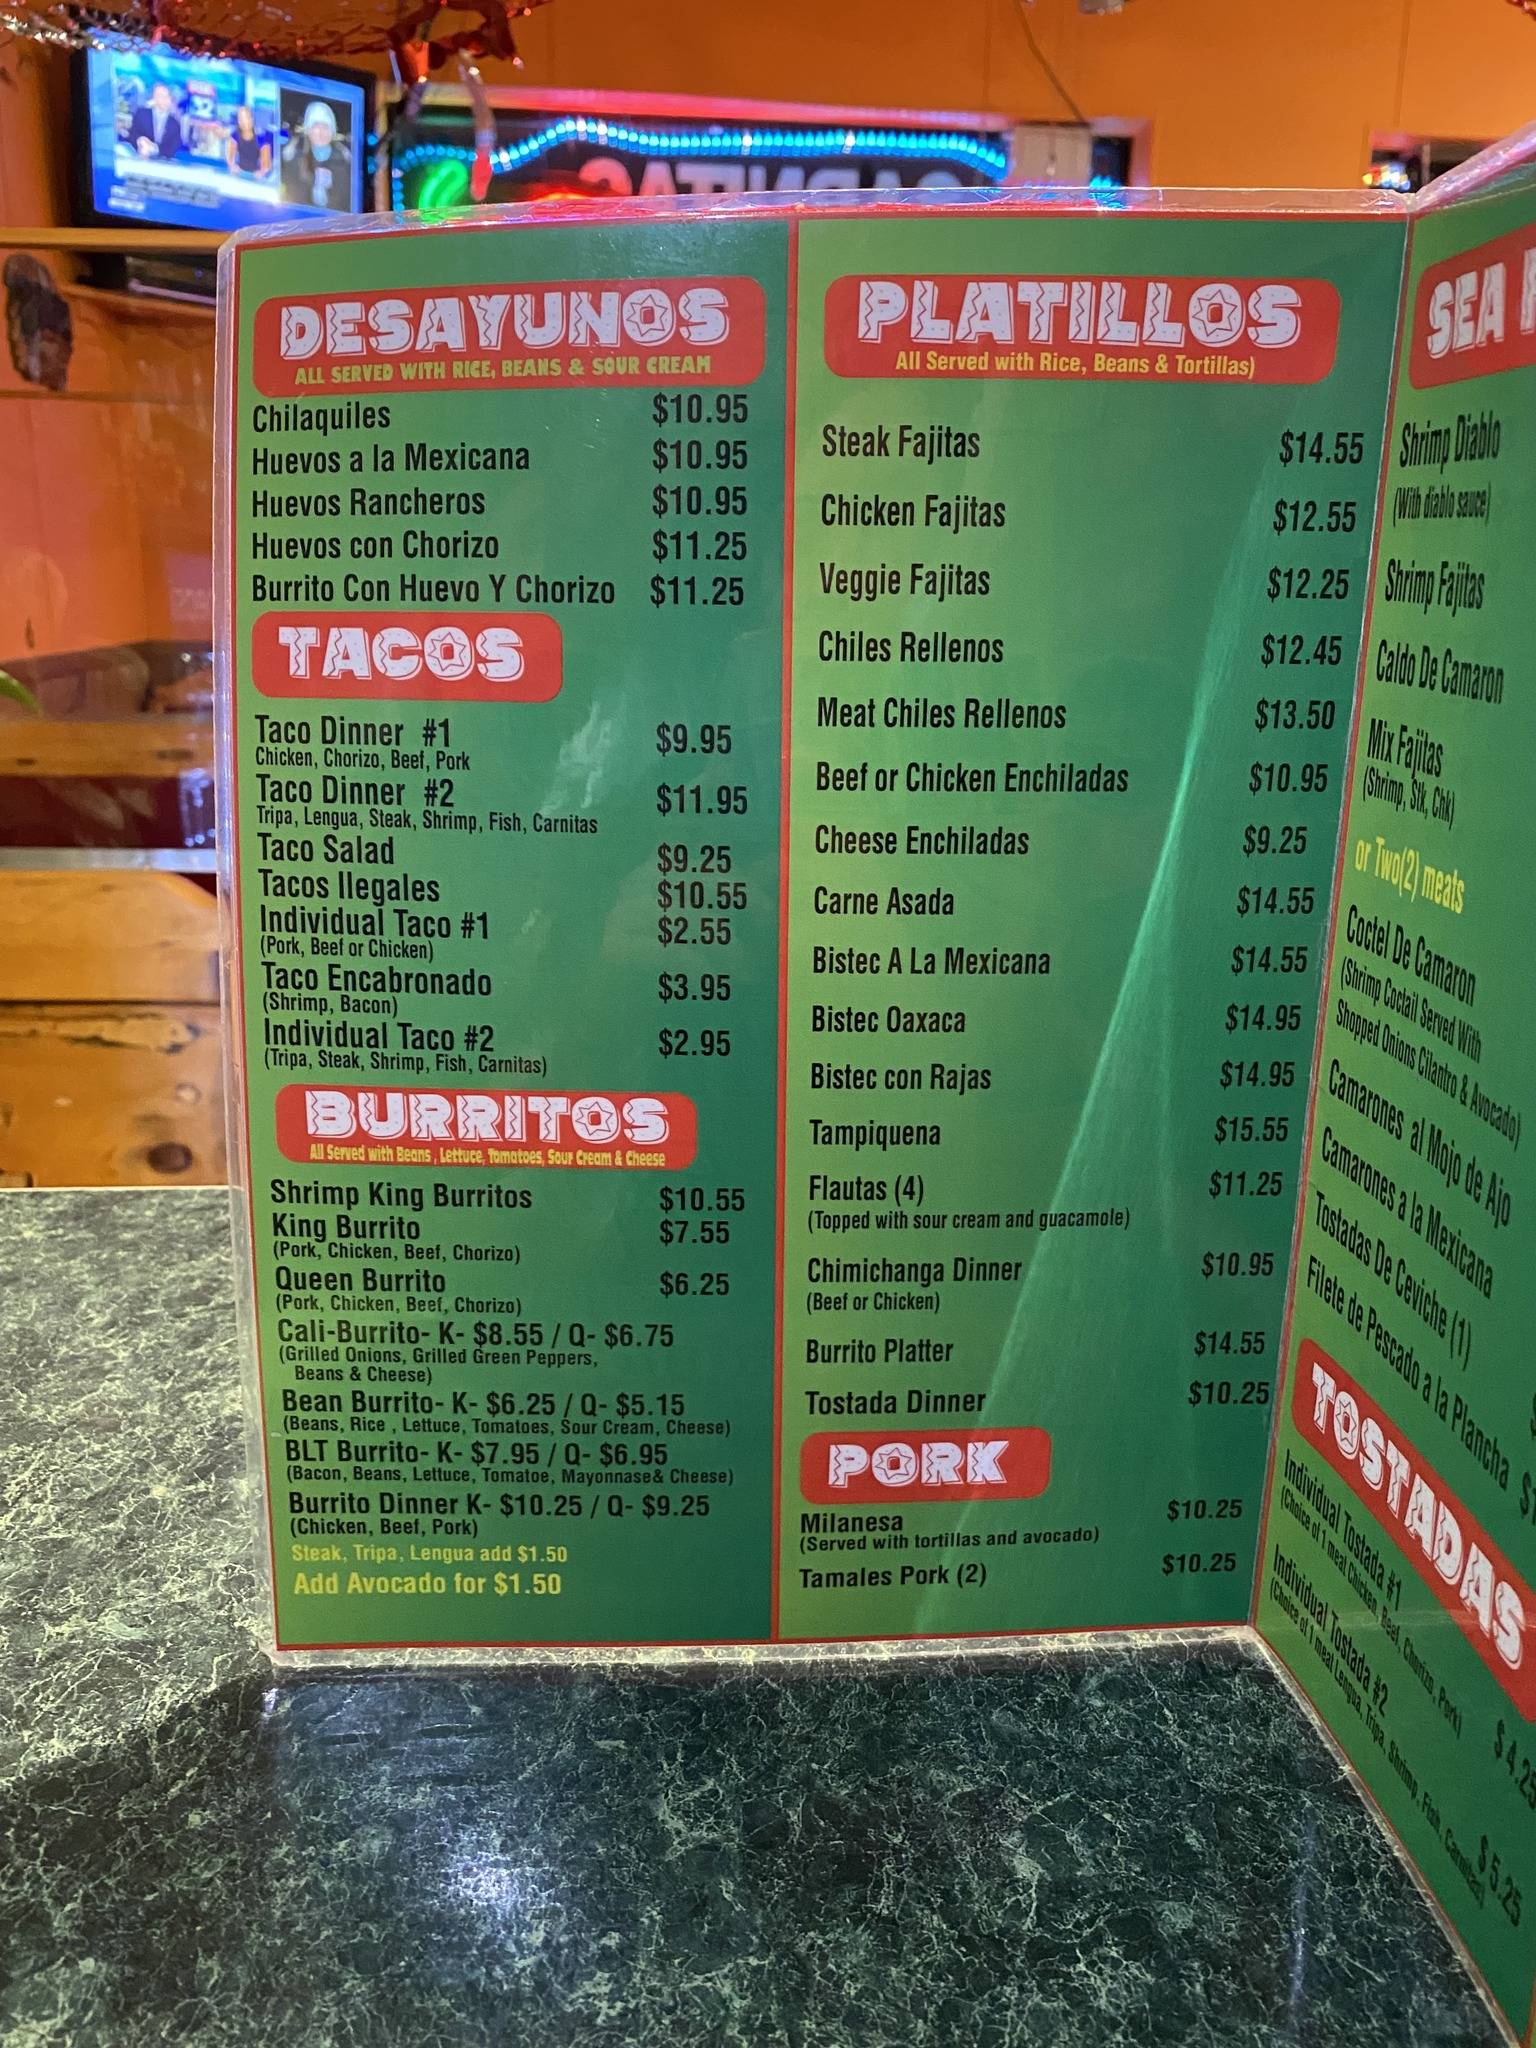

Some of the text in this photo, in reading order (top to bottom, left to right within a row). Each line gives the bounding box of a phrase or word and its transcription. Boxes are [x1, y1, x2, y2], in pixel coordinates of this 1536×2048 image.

[280, 288, 729, 360] DESAYUNOS
[857, 280, 1302, 349] PLATILLOS
[1427, 262, 1507, 360] SEA
[295, 355, 710, 385] ALL SERVED WITH RICE, BEANS & SOUR CREAM
[896, 351, 1255, 378] All Served with Rice, Beans & Tortillas)
[253, 392, 748, 437] Chilaquiles $10.95
[253, 437, 748, 475] Huevos a la Mexicana $10.95
[822, 424, 1364, 468] Steak Fajitas $14.55
[1400, 410, 1501, 474] Shrimp Diablo
[252, 483, 747, 519] Huevos Rancheros $10.95
[252, 528, 747, 564] Huevos con Chorizo $11.25
[819, 562, 1350, 603] Veggie Fajitas $12.25
[278, 626, 525, 681] TACOS
[1376, 639, 1504, 704] Caldo De Camaron
[817, 696, 1335, 733] Meat Chiles Rellenos $13.50
[254, 714, 732, 757] Taco Dinner #1 $9.95
[1367, 718, 1444, 779] Mix Fajitas
[255, 746, 471, 773] Chicken, Chorizo, Beef, Pork
[256, 805, 598, 835] Tripa, Lengua, Steak, Shrimp, Fish, Carnitas
[257, 832, 731, 876] Taco Salad $9.25
[257, 868, 747, 912] Tacos Ilegales $10.55
[1355, 836, 1465, 914] or Two(2) meats
[814, 885, 1315, 918] Carne Asada $14.55
[1347, 904, 1476, 1007] Coctel De Camaron
[260, 961, 731, 1004] Taco Encabronado $3.95
[263, 991, 398, 1019] (Shrimp, Bacon)
[812, 1003, 1301, 1034] Bistec Oaxaca $14.95
[305, 1090, 669, 1146] BURRITOS
[809, 1115, 1289, 1152] Tampiquena $15.55
[1329, 1058, 1511, 1229] Camarones al Mojo de Ajo
[270, 1179, 745, 1214] Shrimp King Burritos $10.55
[809, 1169, 1283, 1207] Flautas (4) $11.25
[808, 1207, 1130, 1234] (Topped with sour cream and guacamole)
[275, 1266, 729, 1299] Queen Burrito $6.25
[1316, 1190, 1471, 1371] Tostadas De Ceviche (1)
[279, 1345, 597, 1368] (Grilled Onions, Grilled Green Peppers,
[806, 1330, 1265, 1364] Burrito Platter $14.55
[285, 1439, 668, 1468] BLT Burrito- K- $7.95 / Q- $6.95
[828, 1440, 1009, 1489] PORK
[801, 1499, 1242, 1534] Milanesa $10.25
[1284, 1449, 1401, 1611] Individual Tostada #1
[1312, 1362, 1526, 1670] TOSTADAS
[292, 1544, 568, 1564] Steak, Tripa, Lengua add $1.50
[799, 1553, 1236, 1589] Tamales Pork (2) $10.25
[294, 1571, 561, 1597] Add Avocado for $1.50
